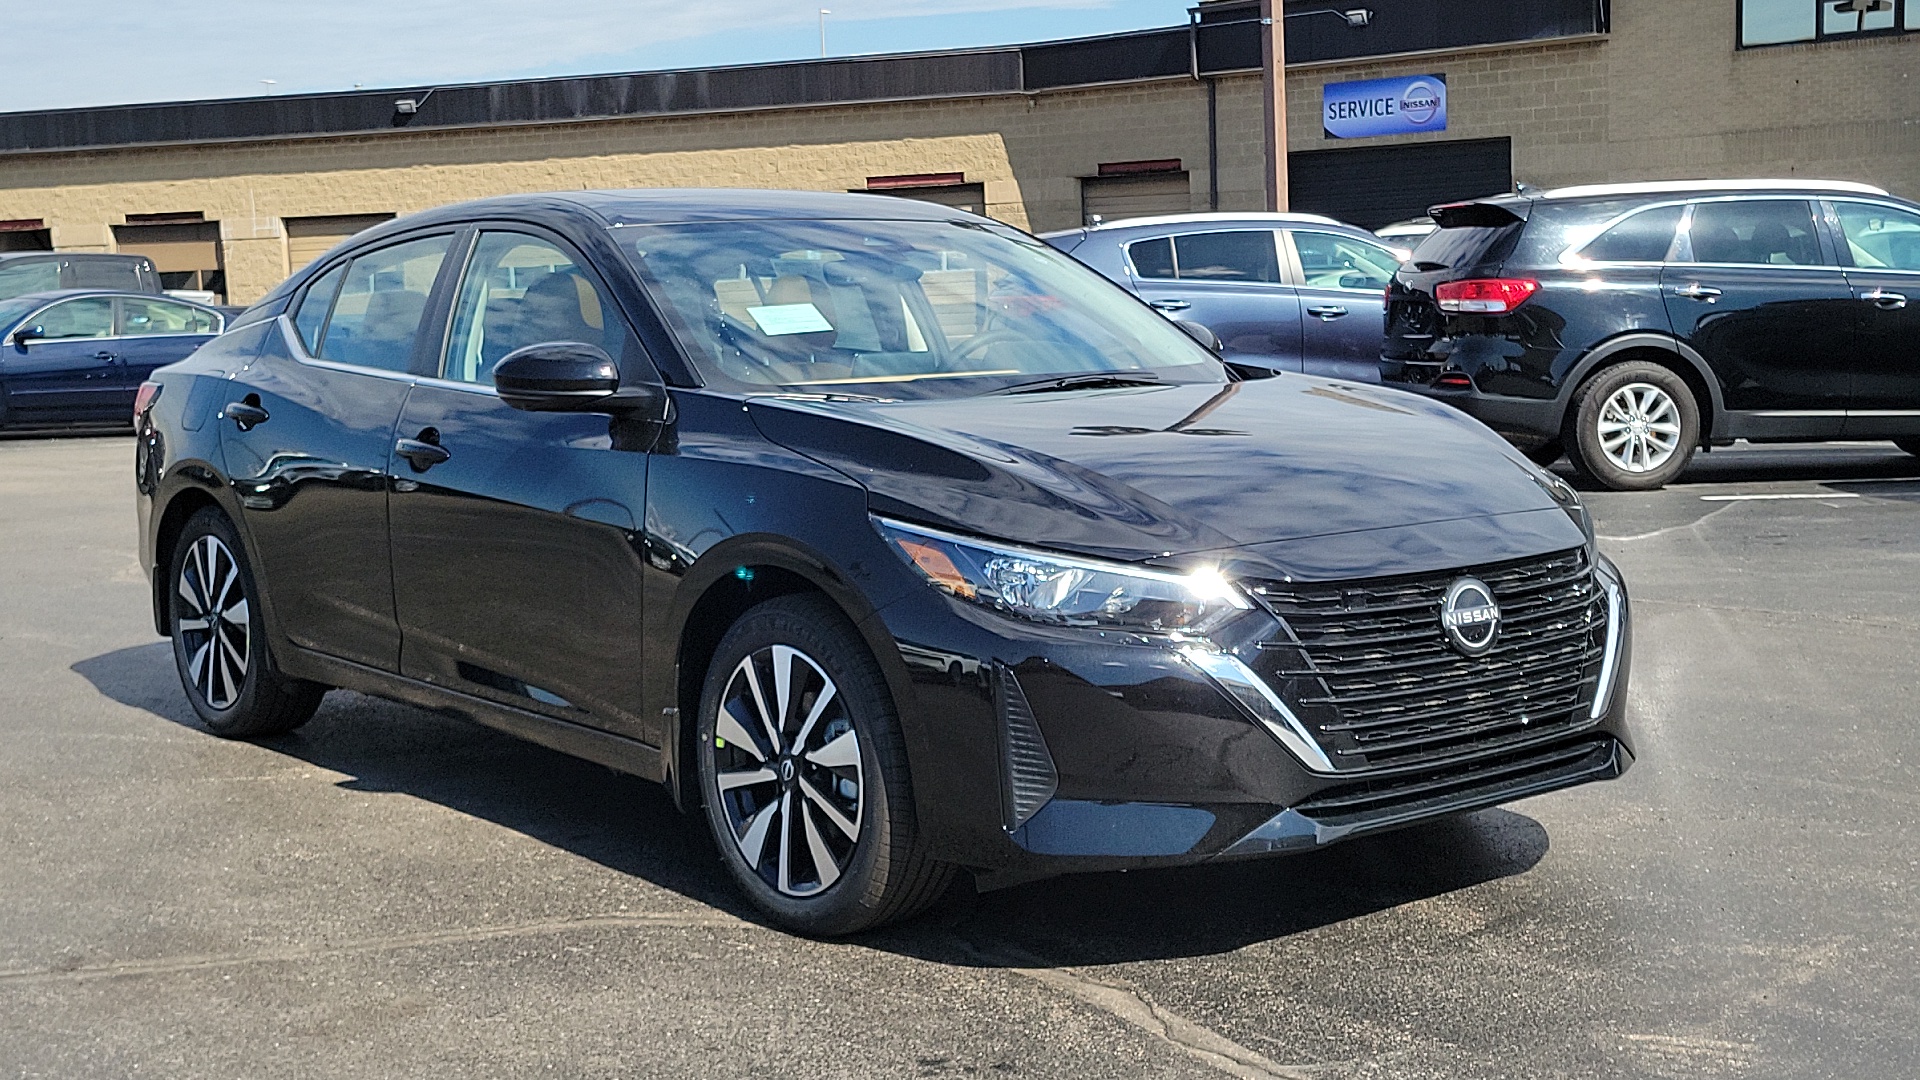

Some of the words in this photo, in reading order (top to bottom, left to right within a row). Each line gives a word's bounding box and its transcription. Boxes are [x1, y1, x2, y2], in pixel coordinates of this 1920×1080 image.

[1328, 97, 1395, 120] SERVICE
[1402, 98, 1437, 109] NISSAN
[1445, 607, 1499, 626] NISSAN
